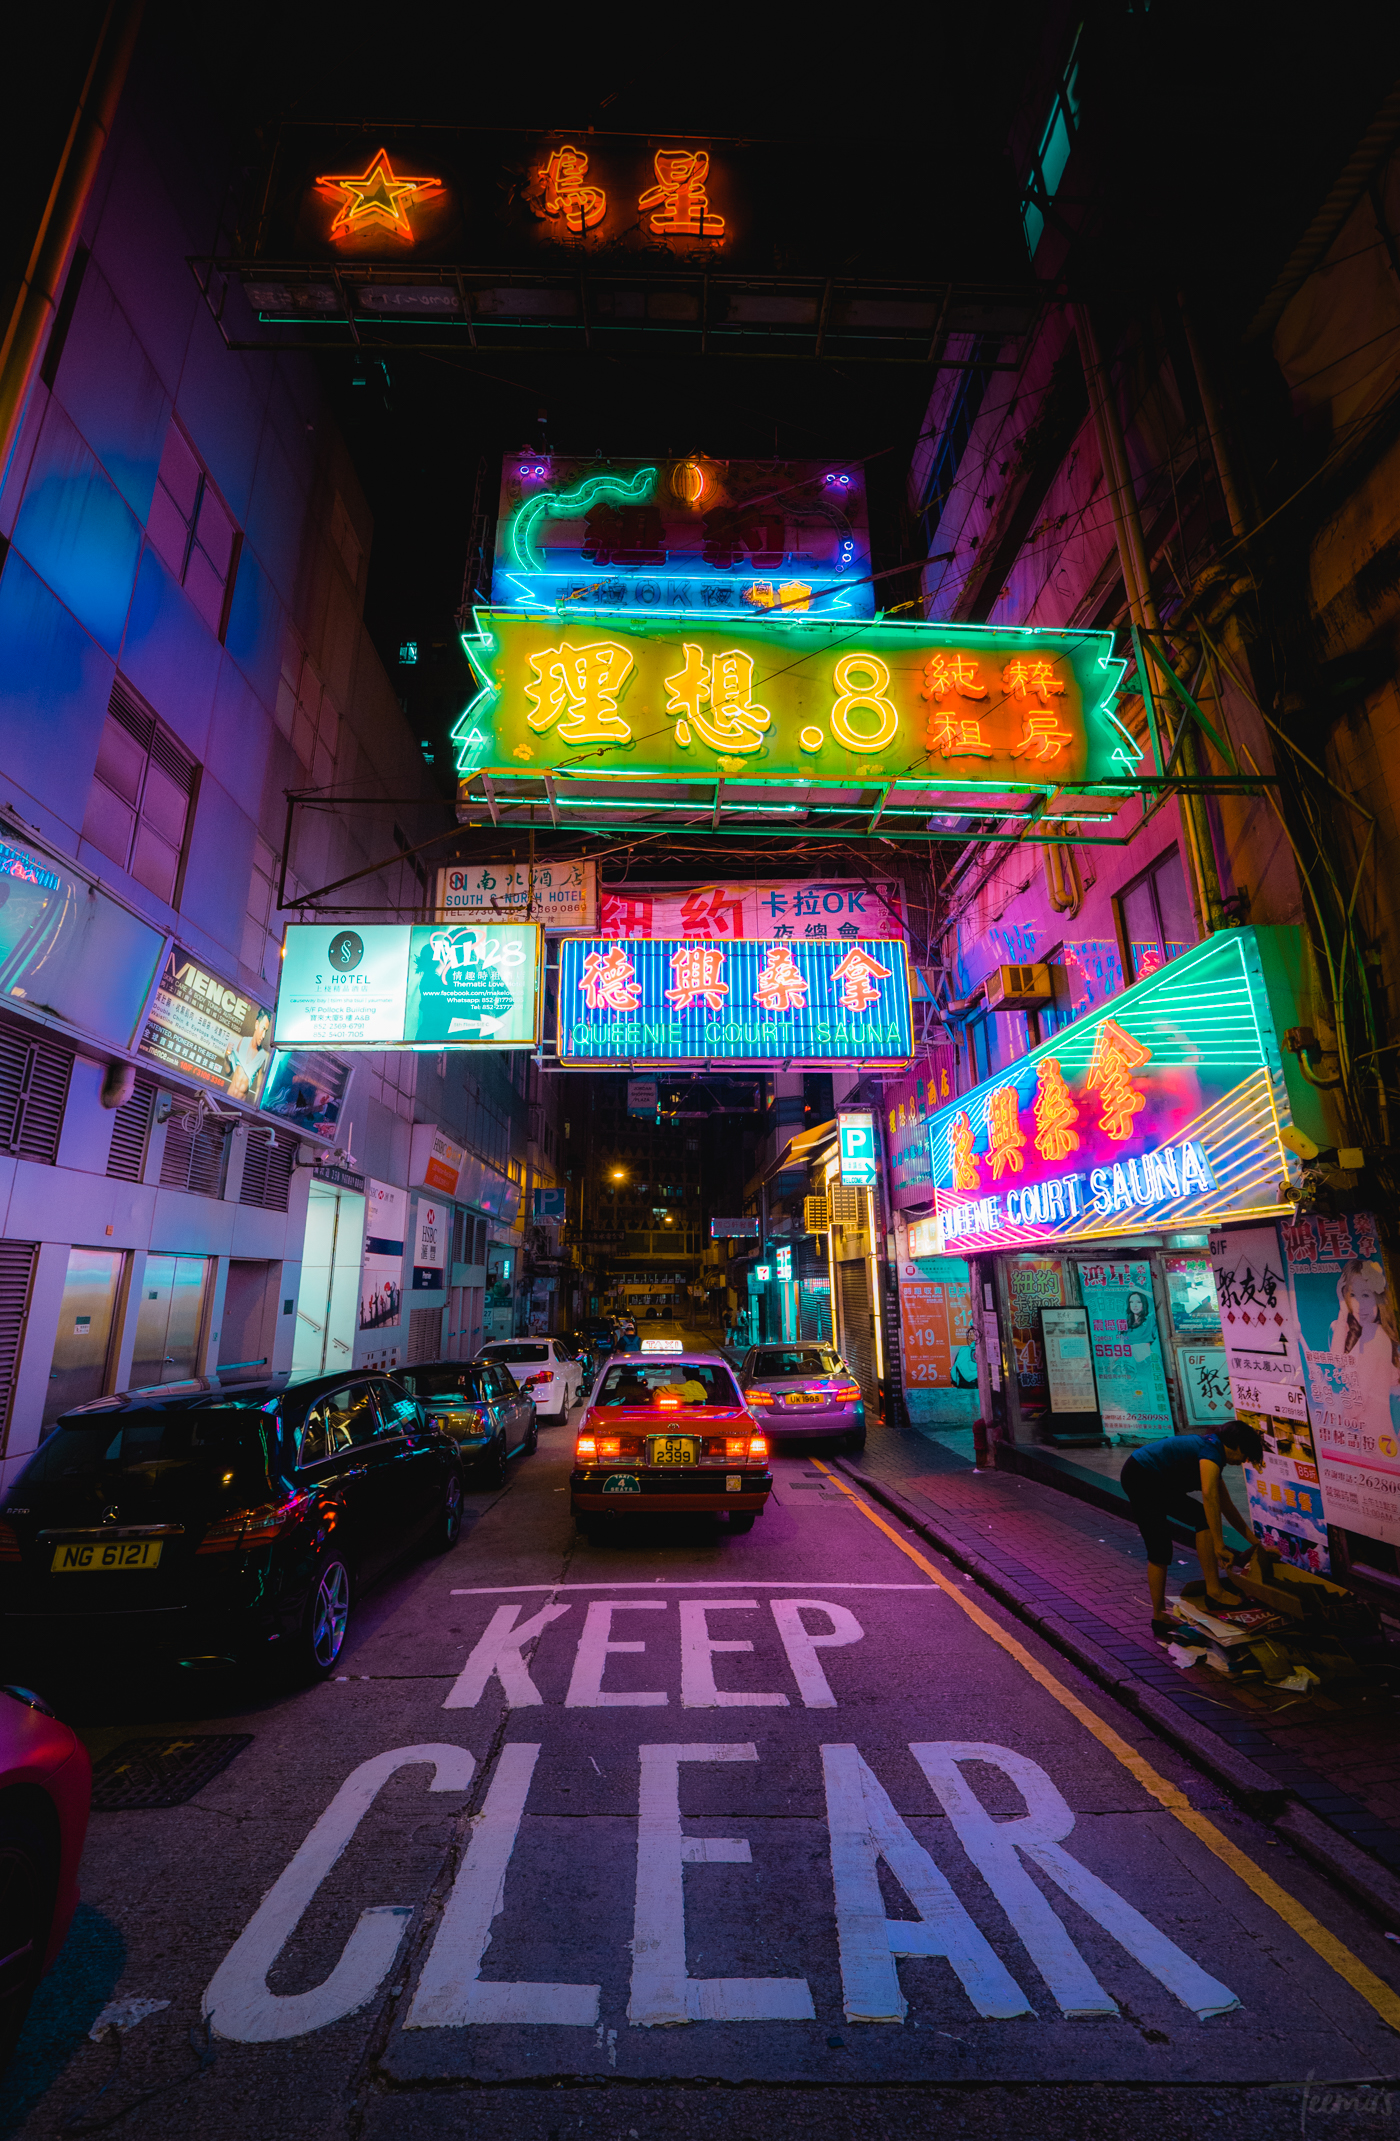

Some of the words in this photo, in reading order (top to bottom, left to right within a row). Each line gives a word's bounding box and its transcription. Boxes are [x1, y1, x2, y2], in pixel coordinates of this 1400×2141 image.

[925, 710, 1074, 759] 租房
[446, 894, 483, 906] SOUTH
[504, 892, 542, 904] NORH
[549, 890, 586, 902] HOTEL
[762, 890, 868, 917] 卡拉OK
[315, 975, 322, 984] S
[331, 975, 371, 984] HOTEL
[579, 946, 893, 1011] 德興桑拿
[345, 1006, 377, 1014] Building
[571, 1022, 683, 1045] QUEENIE
[704, 1022, 793, 1045] COURT
[815, 1022, 902, 1045] SAUNA
[433, 1137, 448, 1156] HSBC
[846, 1129, 867, 1157] P
[1006, 1172, 1086, 1227] COURT
[1089, 1140, 1219, 1217] SAUNA
[540, 1189, 559, 1214] P
[422, 1225, 438, 1244] HSBC
[1281, 1213, 1358, 1262] 鴻星
[1210, 1239, 1227, 1256] 6/F
[1082, 1264, 1131, 1287] 鴻星
[1289, 1263, 1310, 1274] STAR
[1310, 1262, 1343, 1274] SAUNA
[1011, 1269, 1060, 1295] 紐約
[1214, 1263, 1285, 1309] 聚友會
[645, 1341, 680, 1350] TAXI
[909, 1328, 935, 1346] $19
[1093, 1334, 1114, 1342] Special
[1095, 1344, 1133, 1357] $599
[1188, 1355, 1206, 1365] 6/F
[911, 1363, 938, 1381] $25
[1287, 1391, 1304, 1405] 6/F
[1316, 1408, 1366, 1430] 7/Floor
[664, 1440, 682, 1451] GJ
[656, 1451, 691, 1463] 2399
[618, 1479, 625, 1487] 4
[63, 1546, 94, 1568] NG
[102, 1543, 149, 1566] 6121
[440, 1598, 866, 1710] KEEP
[201, 1741, 1242, 2045] CLEAR
